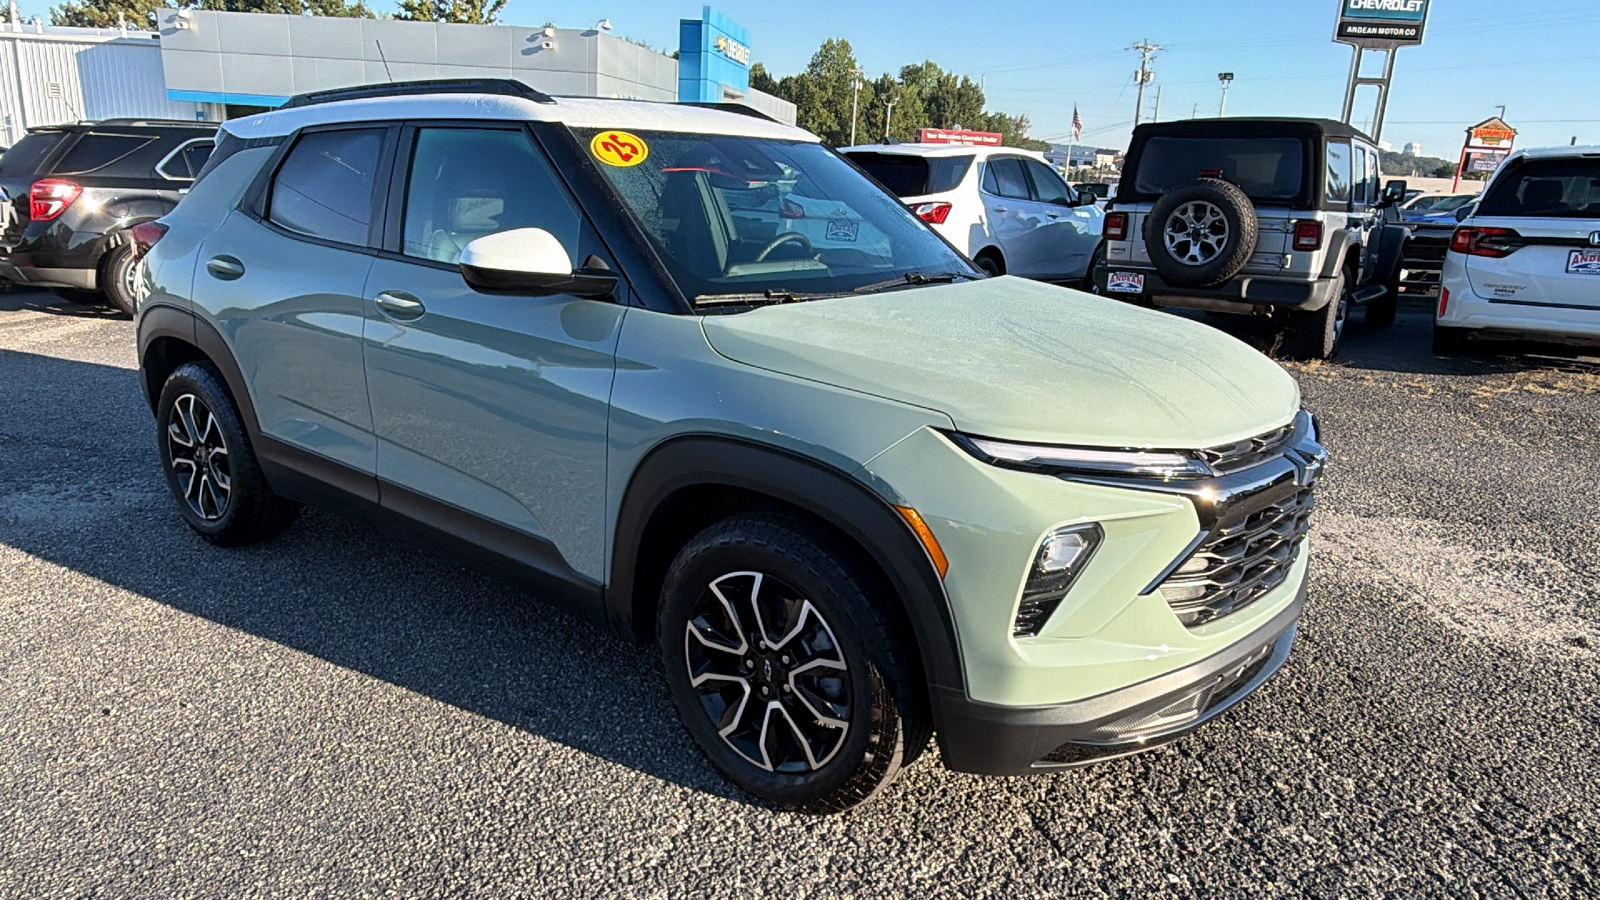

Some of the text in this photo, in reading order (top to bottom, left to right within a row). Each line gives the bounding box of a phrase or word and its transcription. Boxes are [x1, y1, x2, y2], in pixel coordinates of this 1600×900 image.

[1349, 0, 1424, 12] CHEVROLET
[1346, 26, 1416, 36] ANDEAN MOTOR CO
[601, 133, 639, 162] 25
[1110, 274, 1144, 288] ANDEAN
